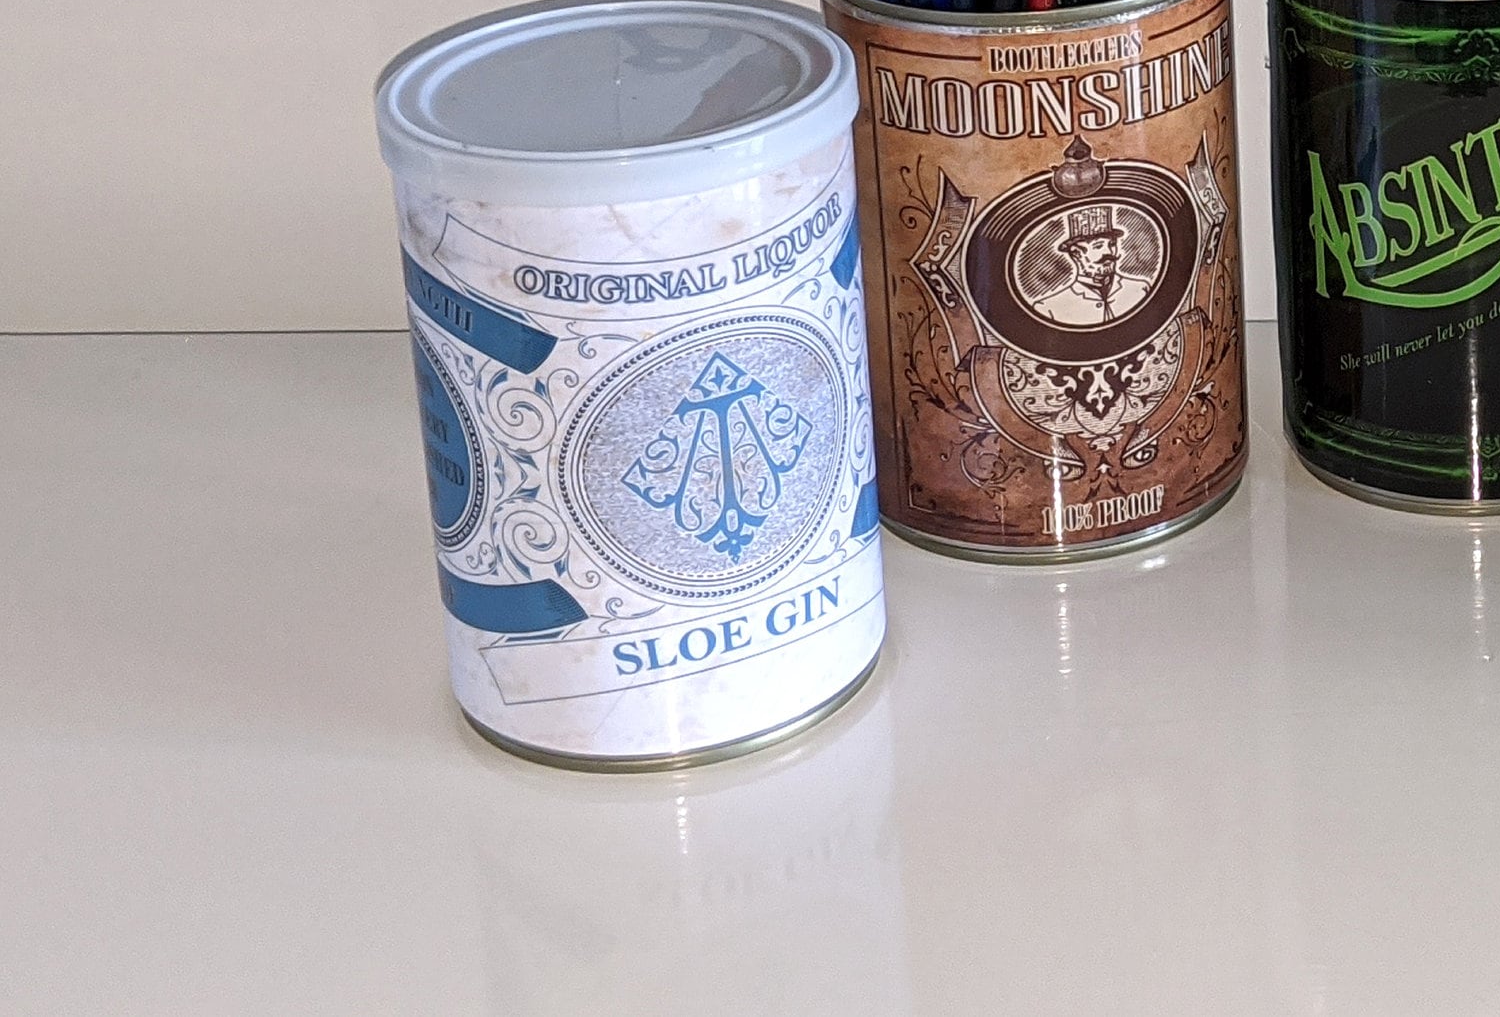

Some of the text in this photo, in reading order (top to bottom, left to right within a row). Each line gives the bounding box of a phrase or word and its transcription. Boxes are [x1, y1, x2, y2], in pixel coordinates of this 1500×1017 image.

[875, 19, 1231, 139] MOONSHINE
[987, 30, 1143, 73] BOOTLEGGERS
[513, 191, 843, 304] ORIGINAL LIQUOR
[1340, 352, 1361, 371] She
[1363, 342, 1391, 365] will
[1394, 334, 1432, 357] never
[1436, 323, 1454, 343] let
[1457, 314, 1484, 340] you
[1096, 484, 1164, 528] PROOF
[612, 575, 841, 676] SLOE GIN
